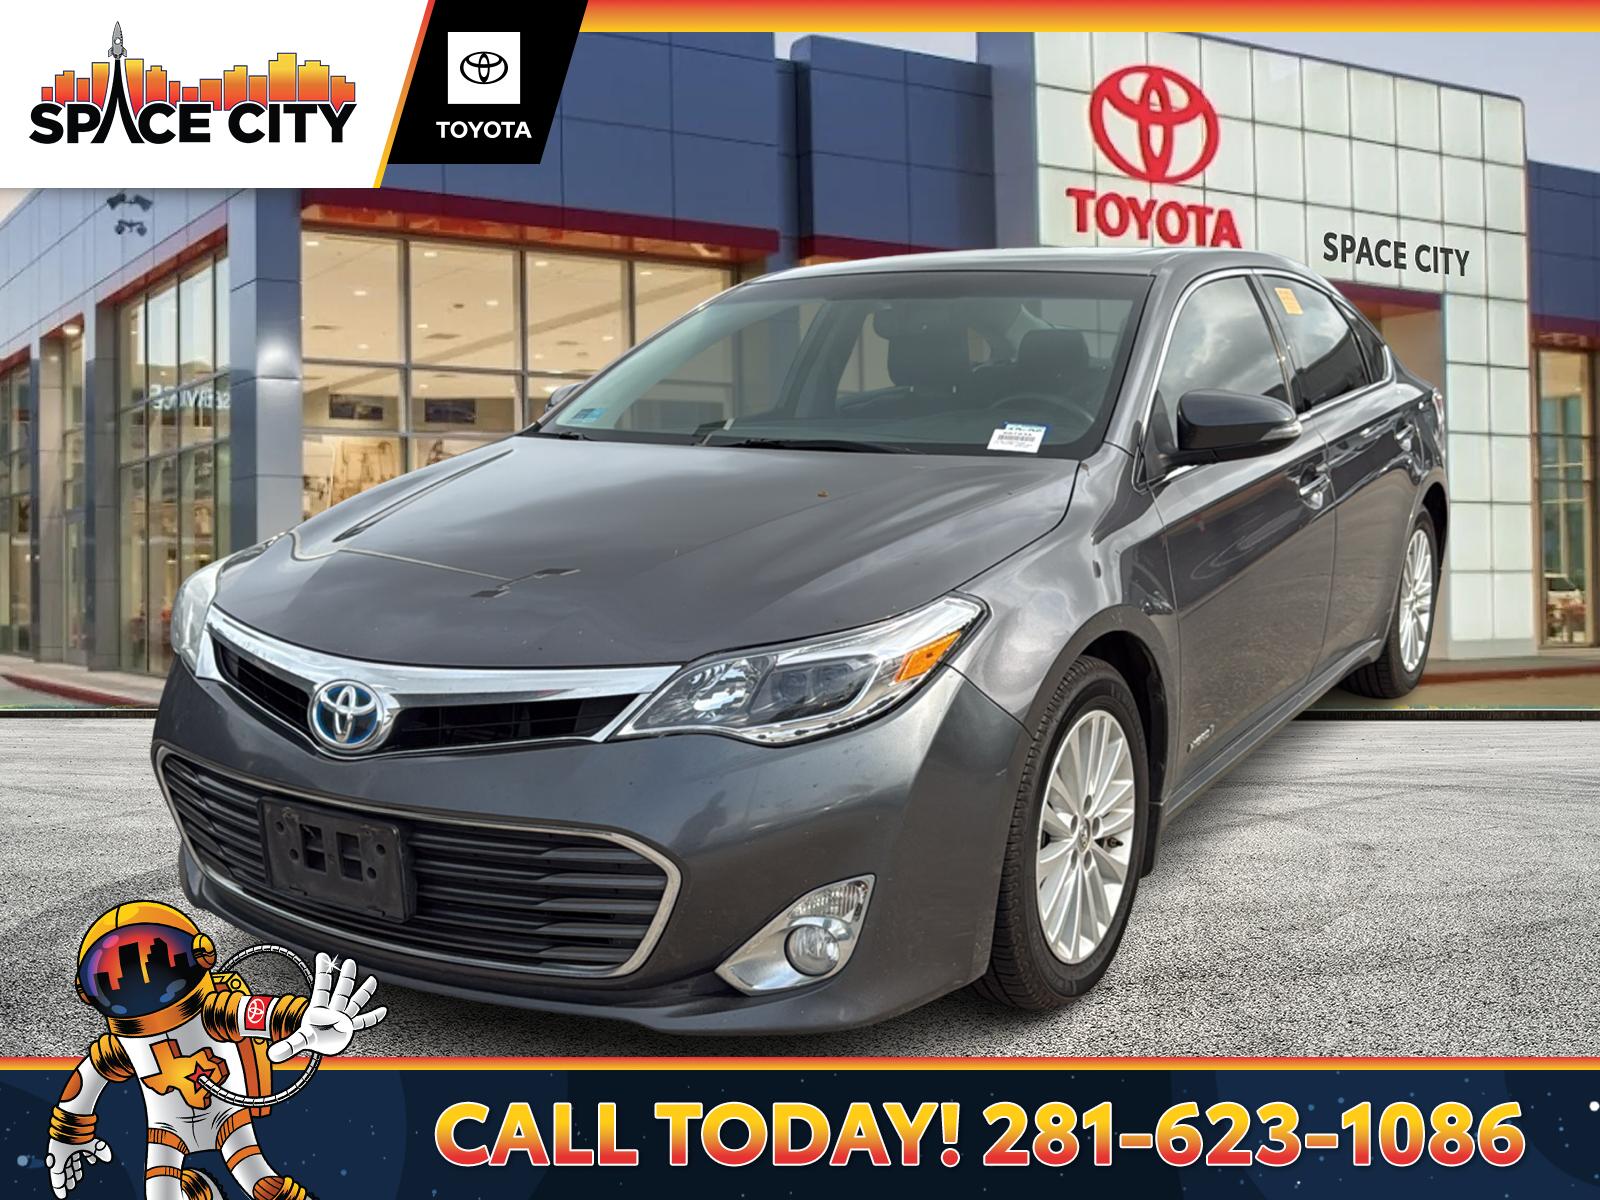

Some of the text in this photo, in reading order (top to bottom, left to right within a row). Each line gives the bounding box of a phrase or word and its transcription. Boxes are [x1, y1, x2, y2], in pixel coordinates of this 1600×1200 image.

[1066, 188, 1242, 248] TOYOTA
[1323, 232, 1470, 277] SPACE CITY
